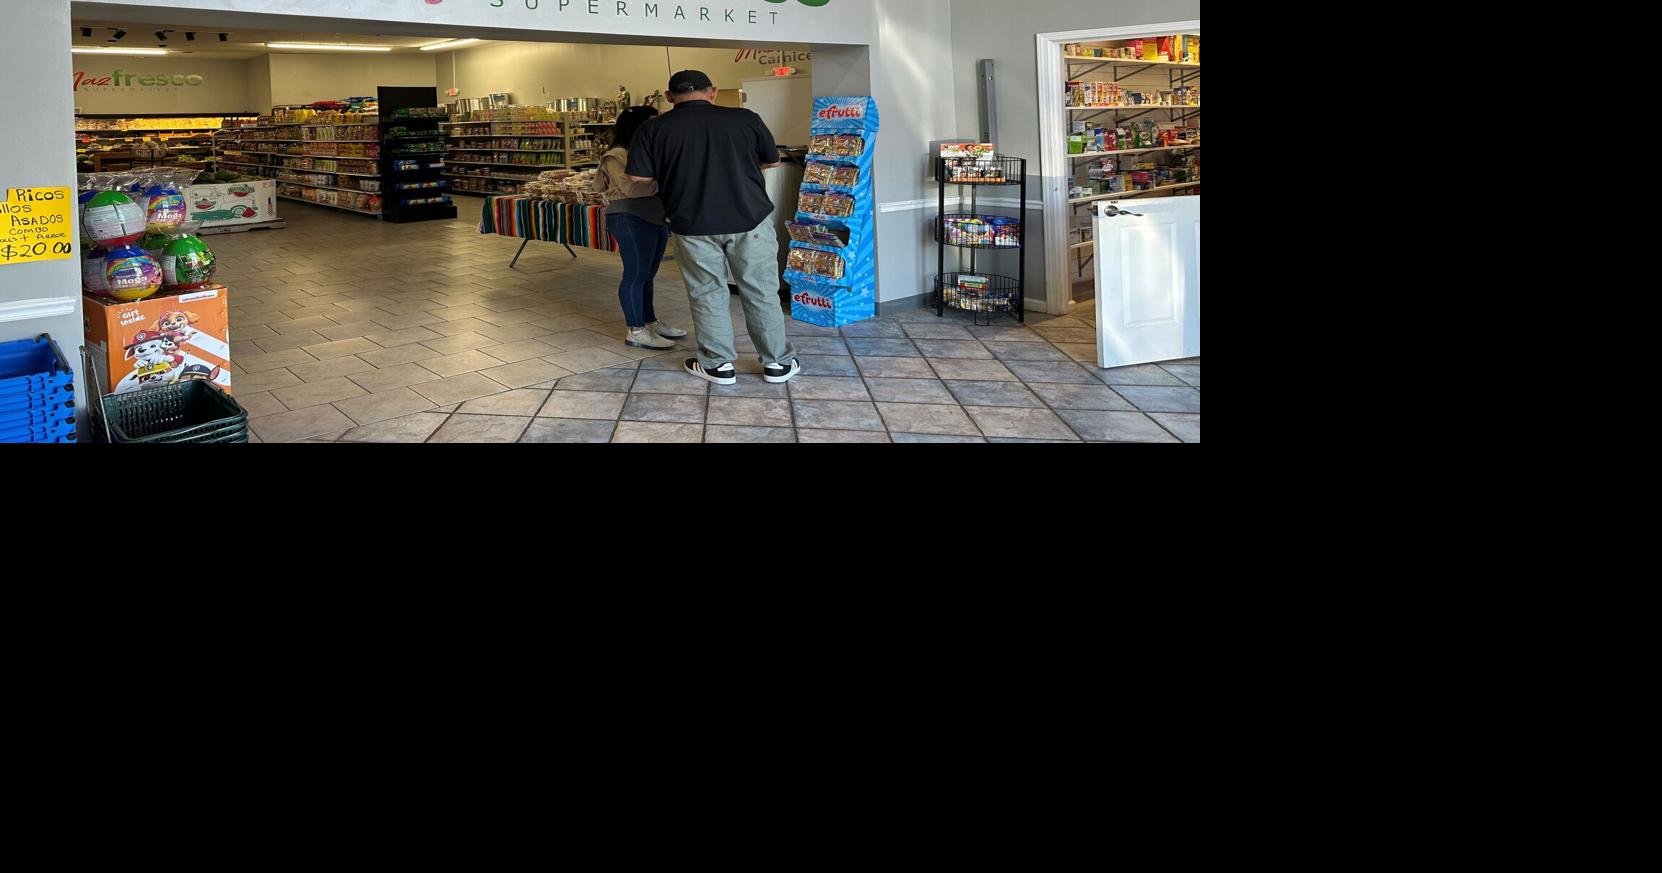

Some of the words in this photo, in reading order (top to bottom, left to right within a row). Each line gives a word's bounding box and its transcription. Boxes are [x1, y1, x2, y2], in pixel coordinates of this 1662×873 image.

[818, 105, 861, 119] efrutti
[0, 203, 32, 214] llos
[11, 214, 64, 226] ASADOS
[0, 242, 47, 261] $20
[793, 292, 832, 309] efrutti
